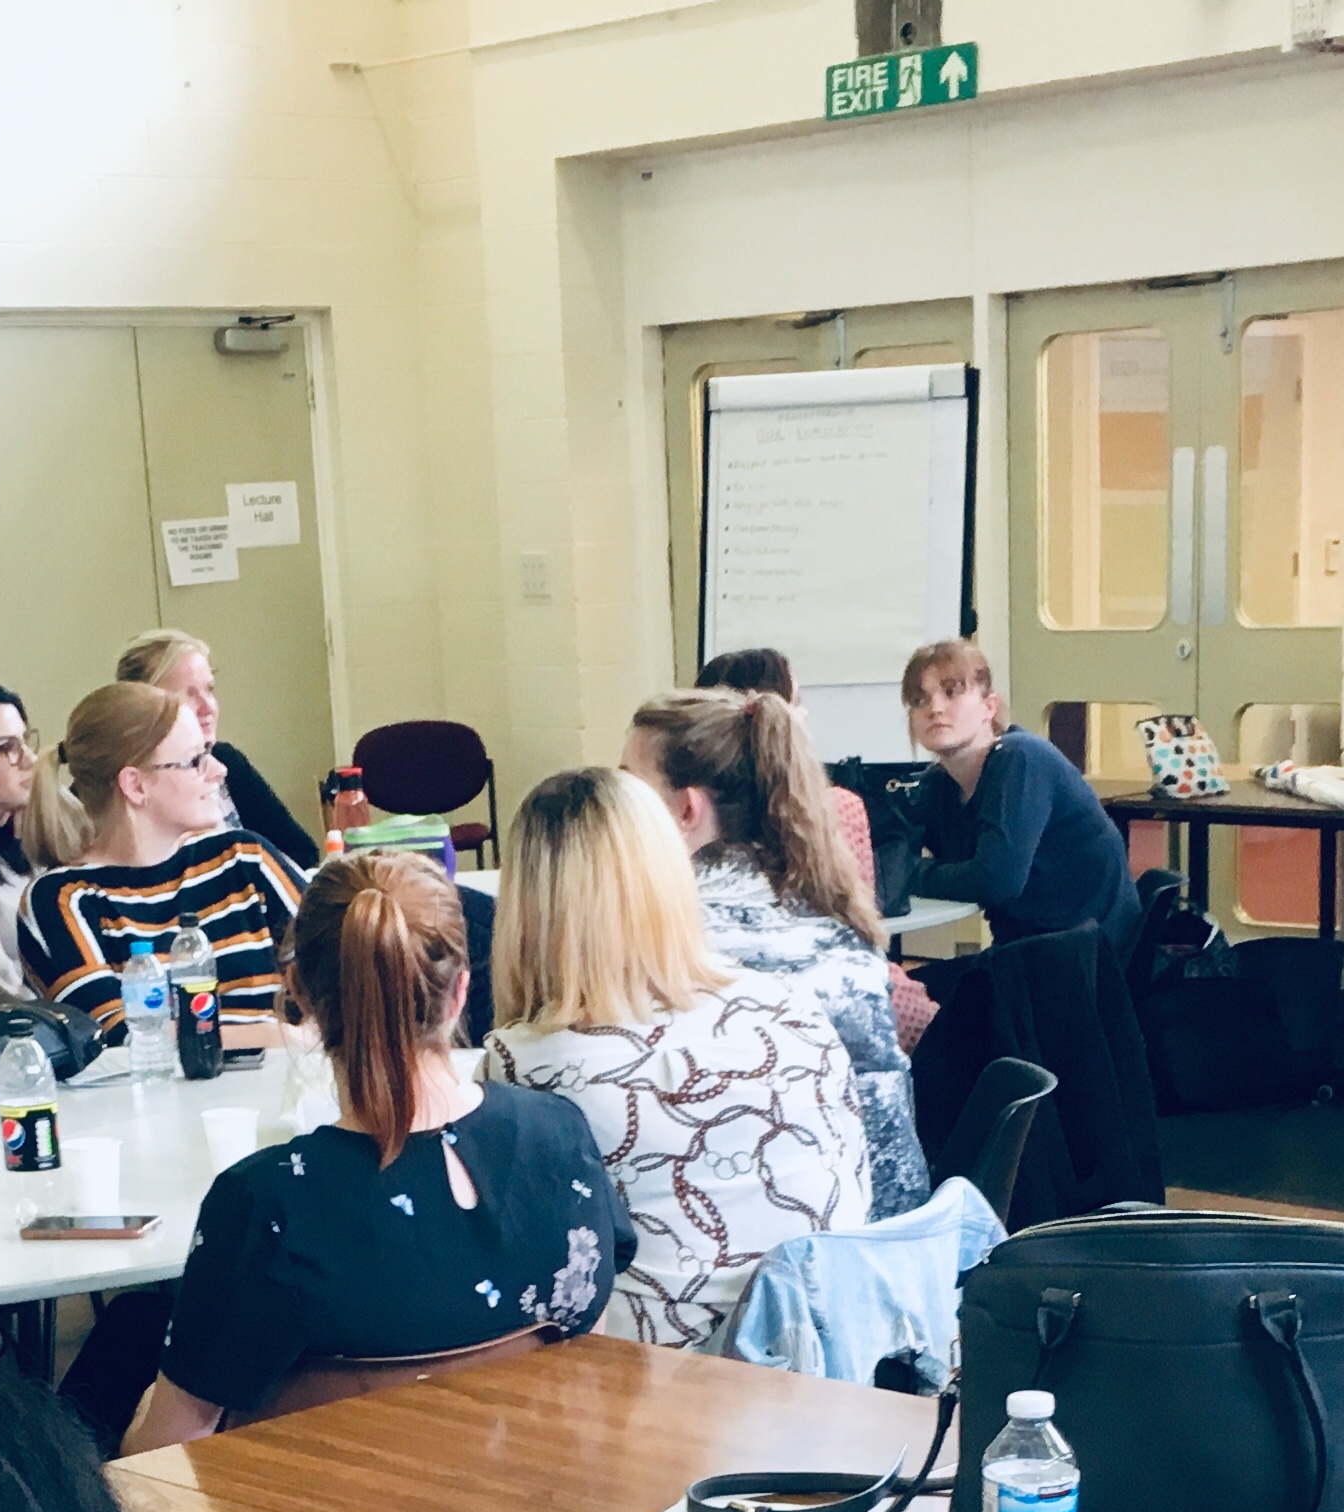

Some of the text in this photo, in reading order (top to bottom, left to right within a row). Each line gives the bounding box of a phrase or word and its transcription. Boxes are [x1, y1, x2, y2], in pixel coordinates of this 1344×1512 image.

[831, 61, 889, 92] FIRE
[830, 85, 888, 117] EXIT
[242, 493, 283, 506] Lecture
[253, 511, 274, 522] Hall
